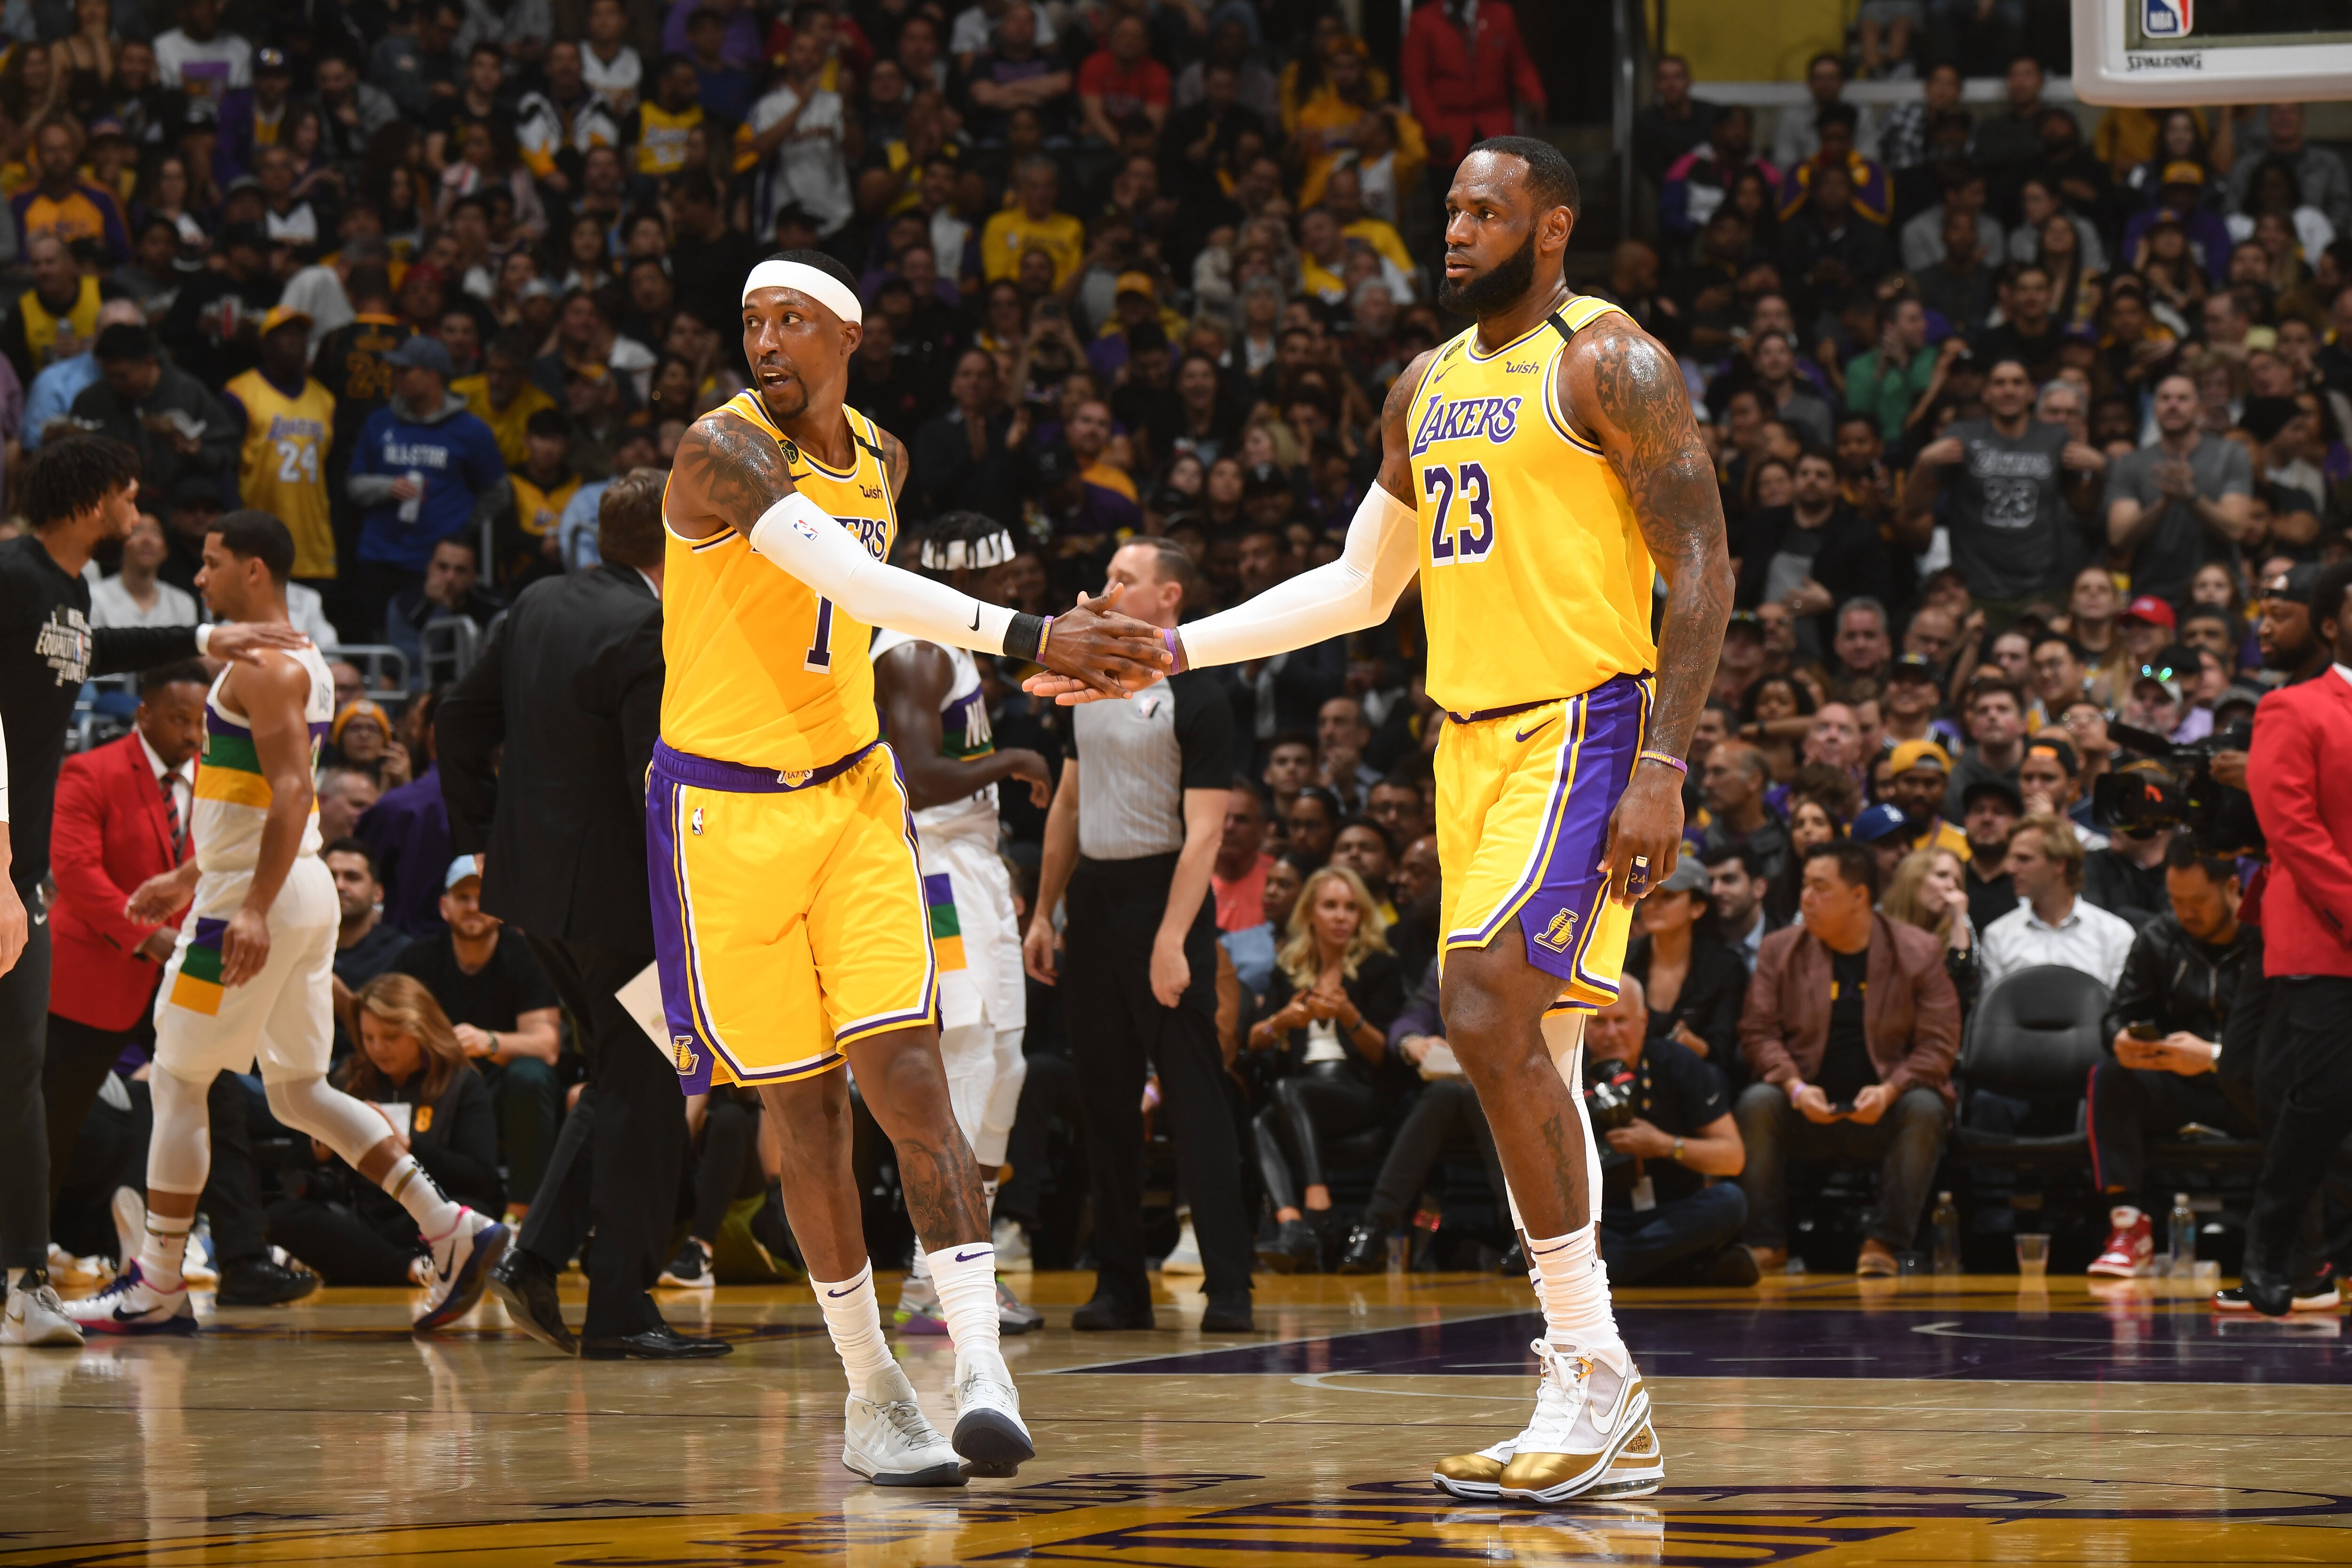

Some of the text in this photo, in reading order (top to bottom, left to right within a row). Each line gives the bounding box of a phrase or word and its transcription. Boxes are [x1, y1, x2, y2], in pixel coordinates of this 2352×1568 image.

[2127, 54, 2202, 71] SPALDING
[1505, 360, 1539, 375] wish
[1410, 392, 1523, 461] LAKERS
[277, 441, 318, 484] 24
[859, 484, 883, 499] wish
[1423, 460, 1495, 567] 23
[1641, 751, 1672, 764] PROMISE
[1630, 873, 1646, 884] 24
